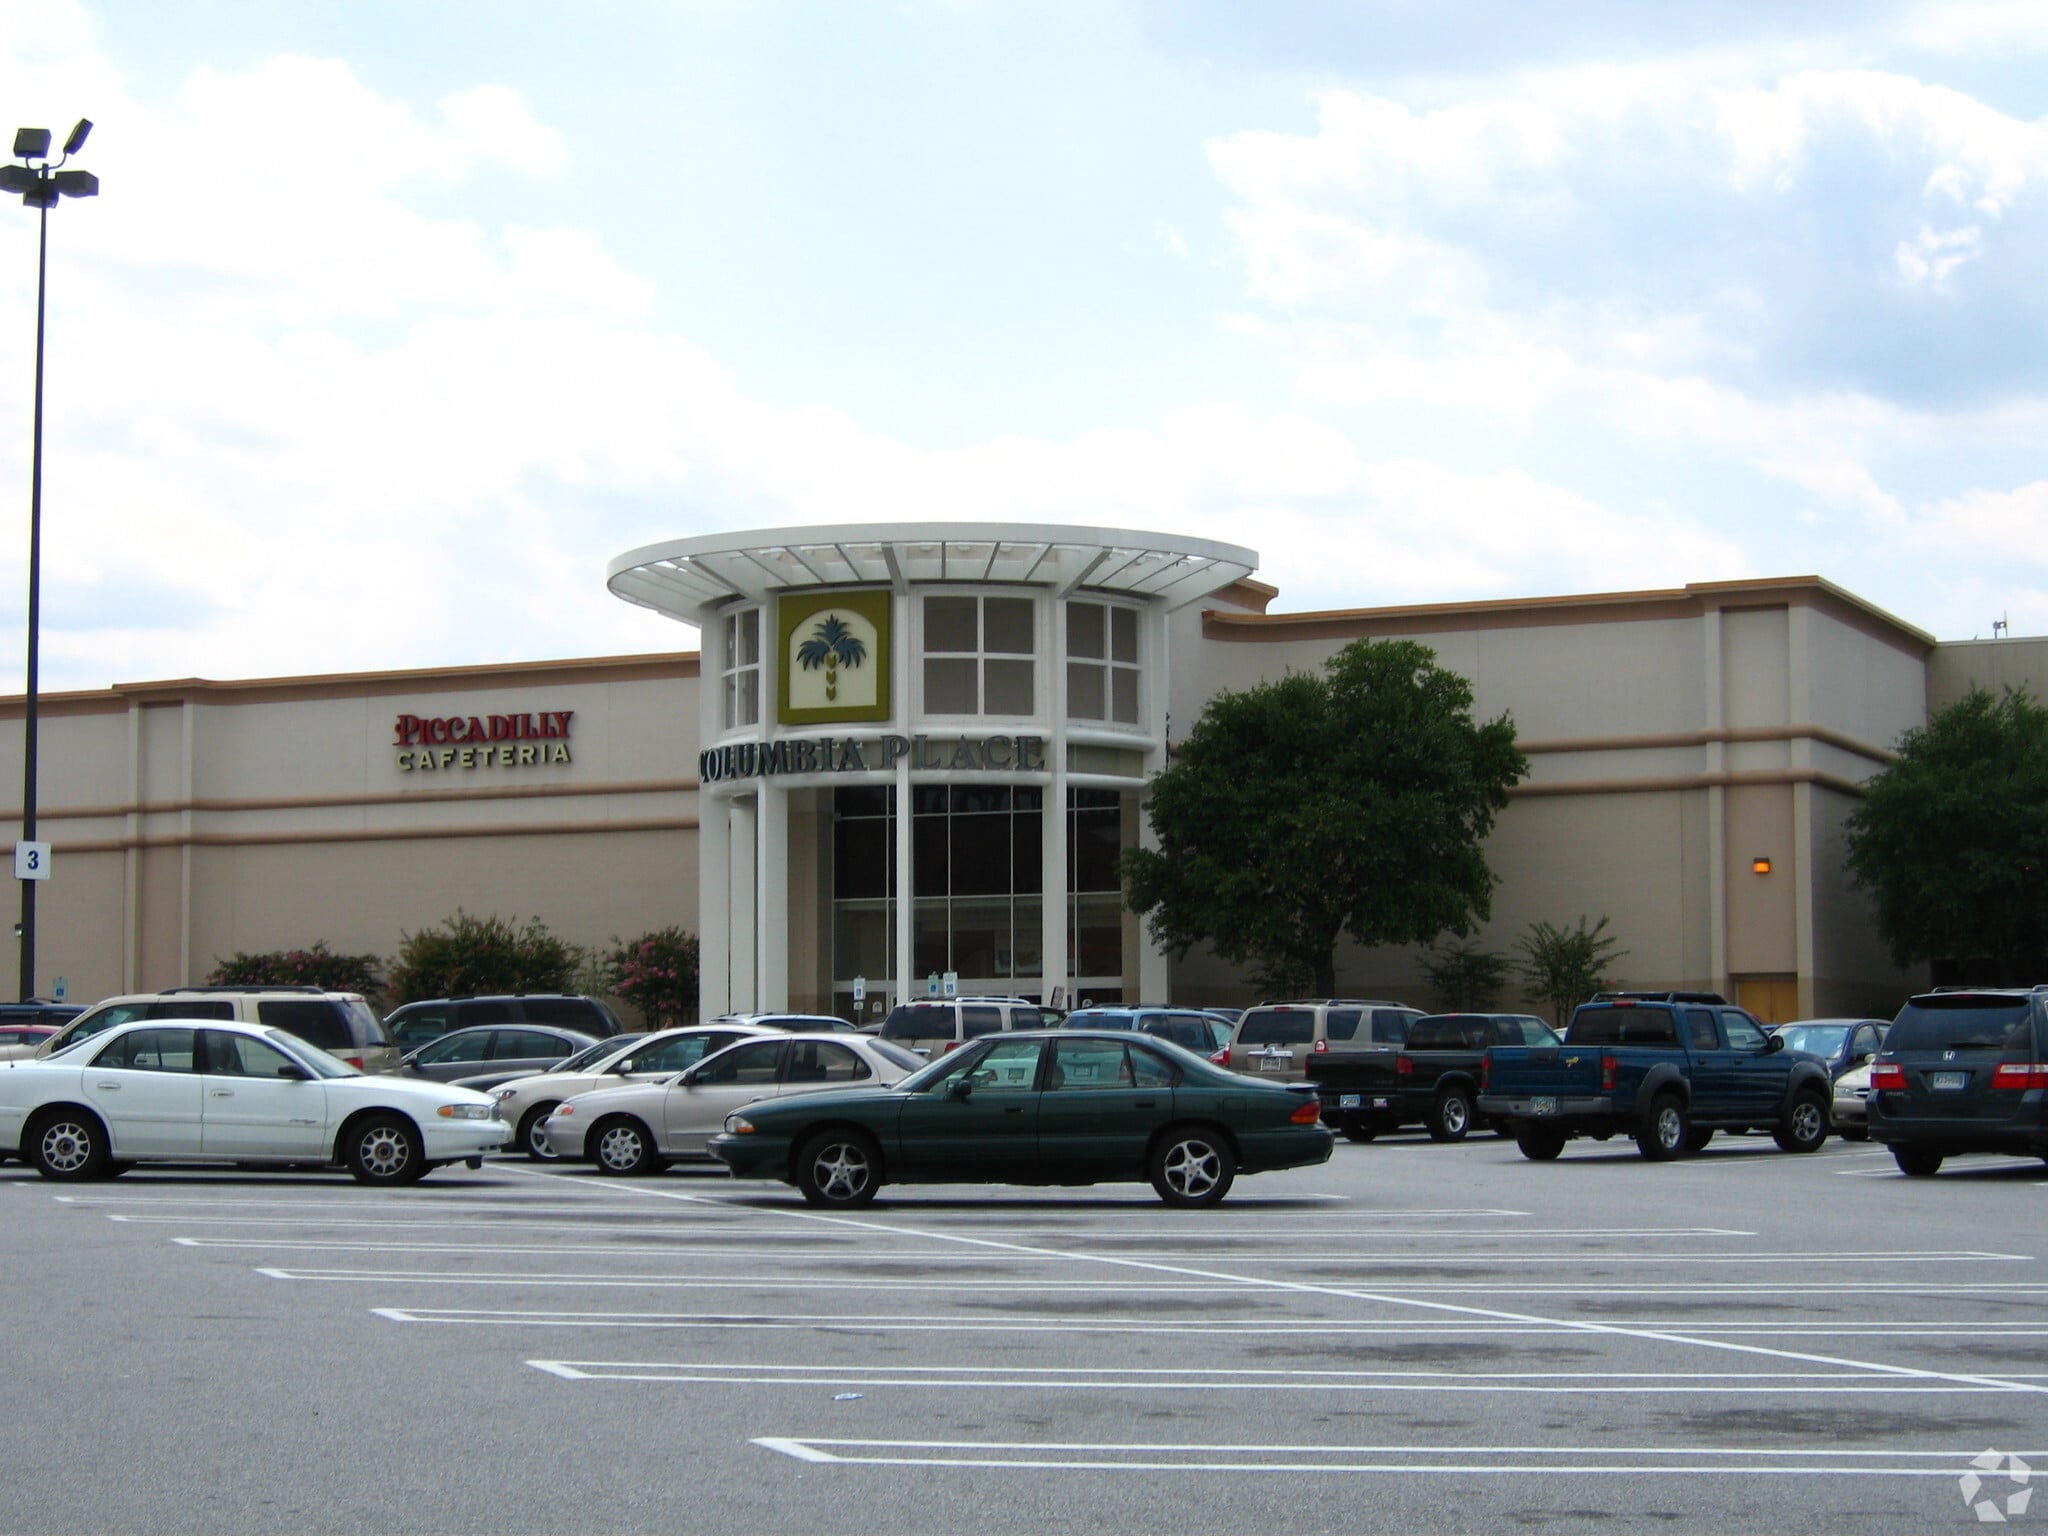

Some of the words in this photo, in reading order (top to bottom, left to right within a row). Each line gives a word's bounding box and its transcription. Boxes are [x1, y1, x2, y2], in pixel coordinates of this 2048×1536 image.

[393, 711, 574, 746] PICCADILLY
[397, 743, 572, 770] CAFETERIA
[880, 734, 1045, 771] PLACE
[27, 850, 39, 870] 3
